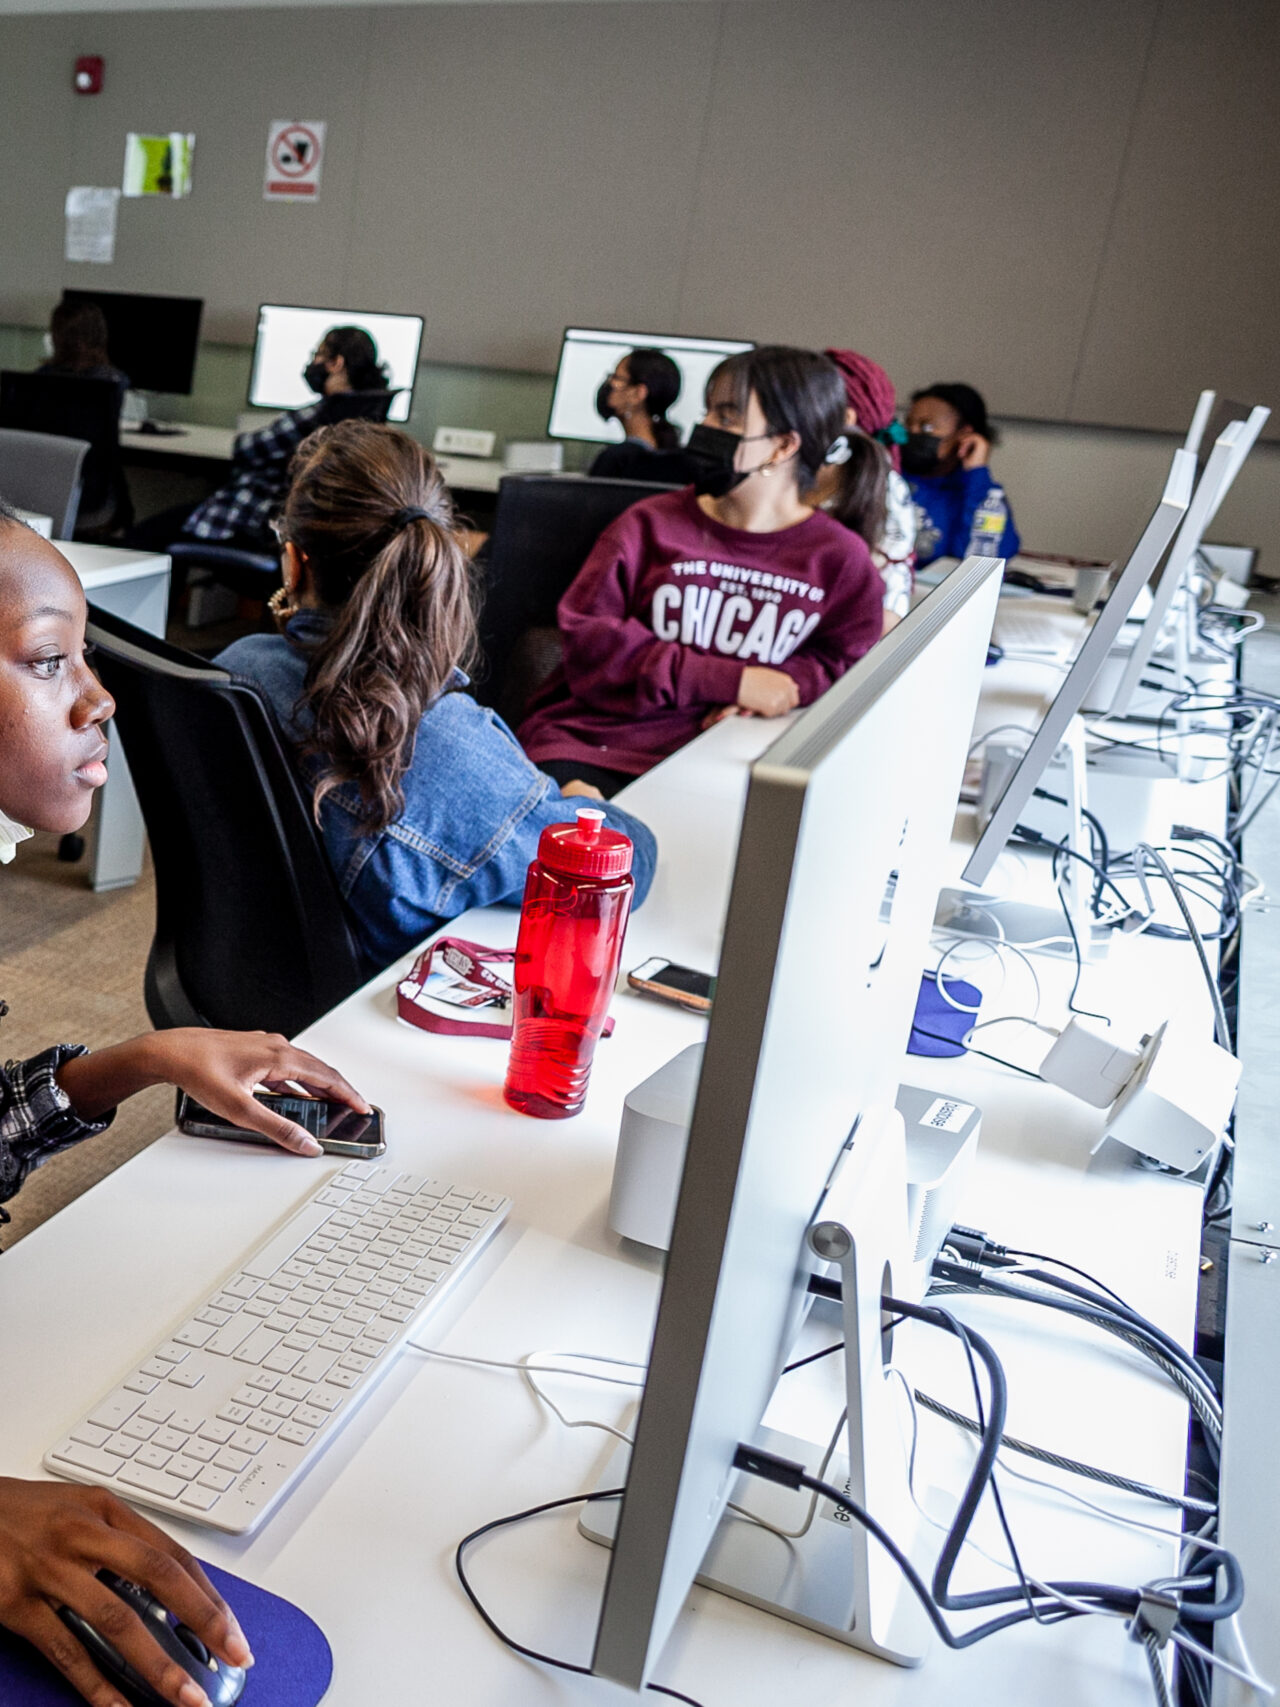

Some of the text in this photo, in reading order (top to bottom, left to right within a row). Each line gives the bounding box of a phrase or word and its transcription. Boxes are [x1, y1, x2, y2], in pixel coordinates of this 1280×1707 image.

[671, 560, 707, 577] THE
[709, 561, 810, 598] UNIVERSITY
[237, 1464, 263, 1493] MACALLY
